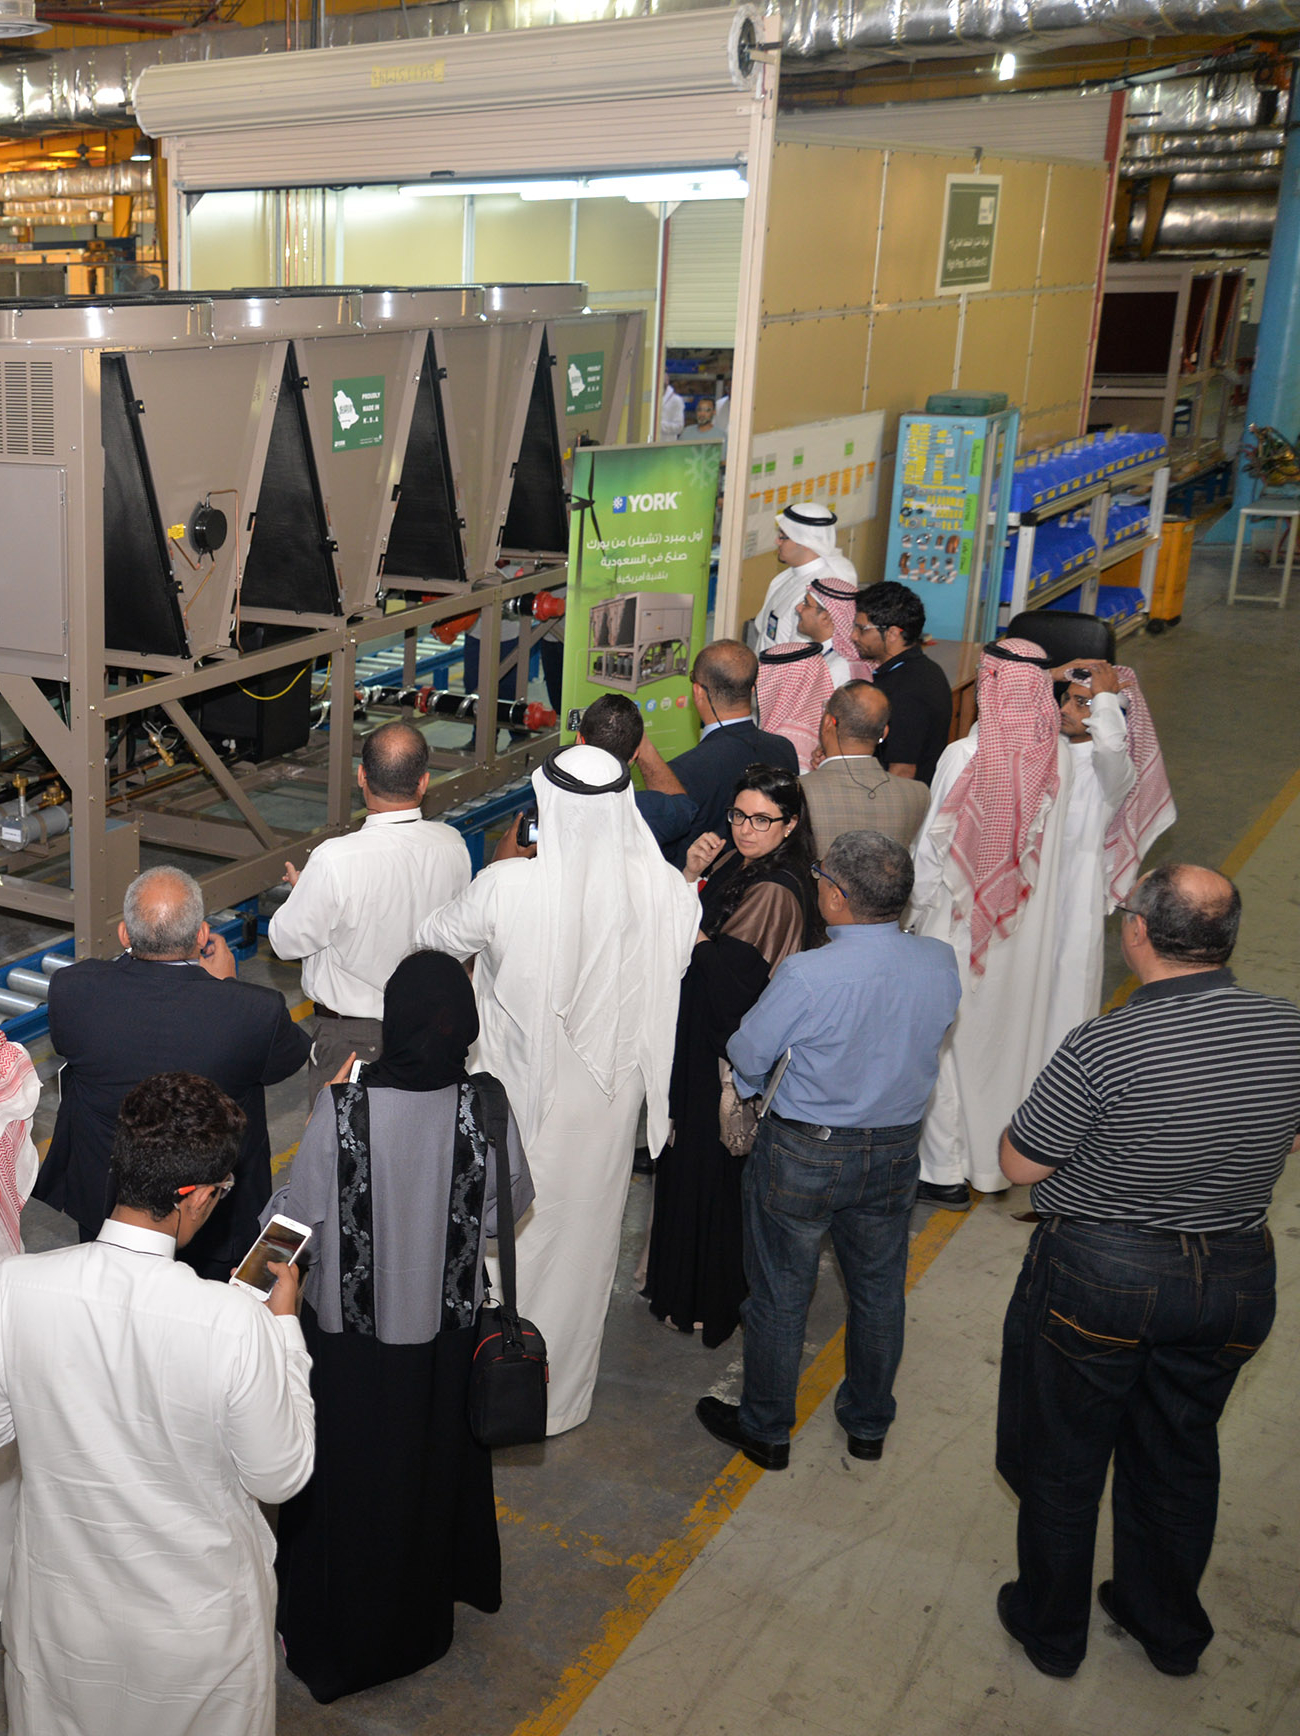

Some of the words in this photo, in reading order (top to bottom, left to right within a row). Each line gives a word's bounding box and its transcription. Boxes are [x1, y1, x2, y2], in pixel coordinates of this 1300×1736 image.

[629, 492, 678, 512] YORK
[611, 539, 626, 549] من
[664, 535, 686, 544] مبرد
[648, 555, 663, 568] في
[664, 552, 688, 563] صنع
